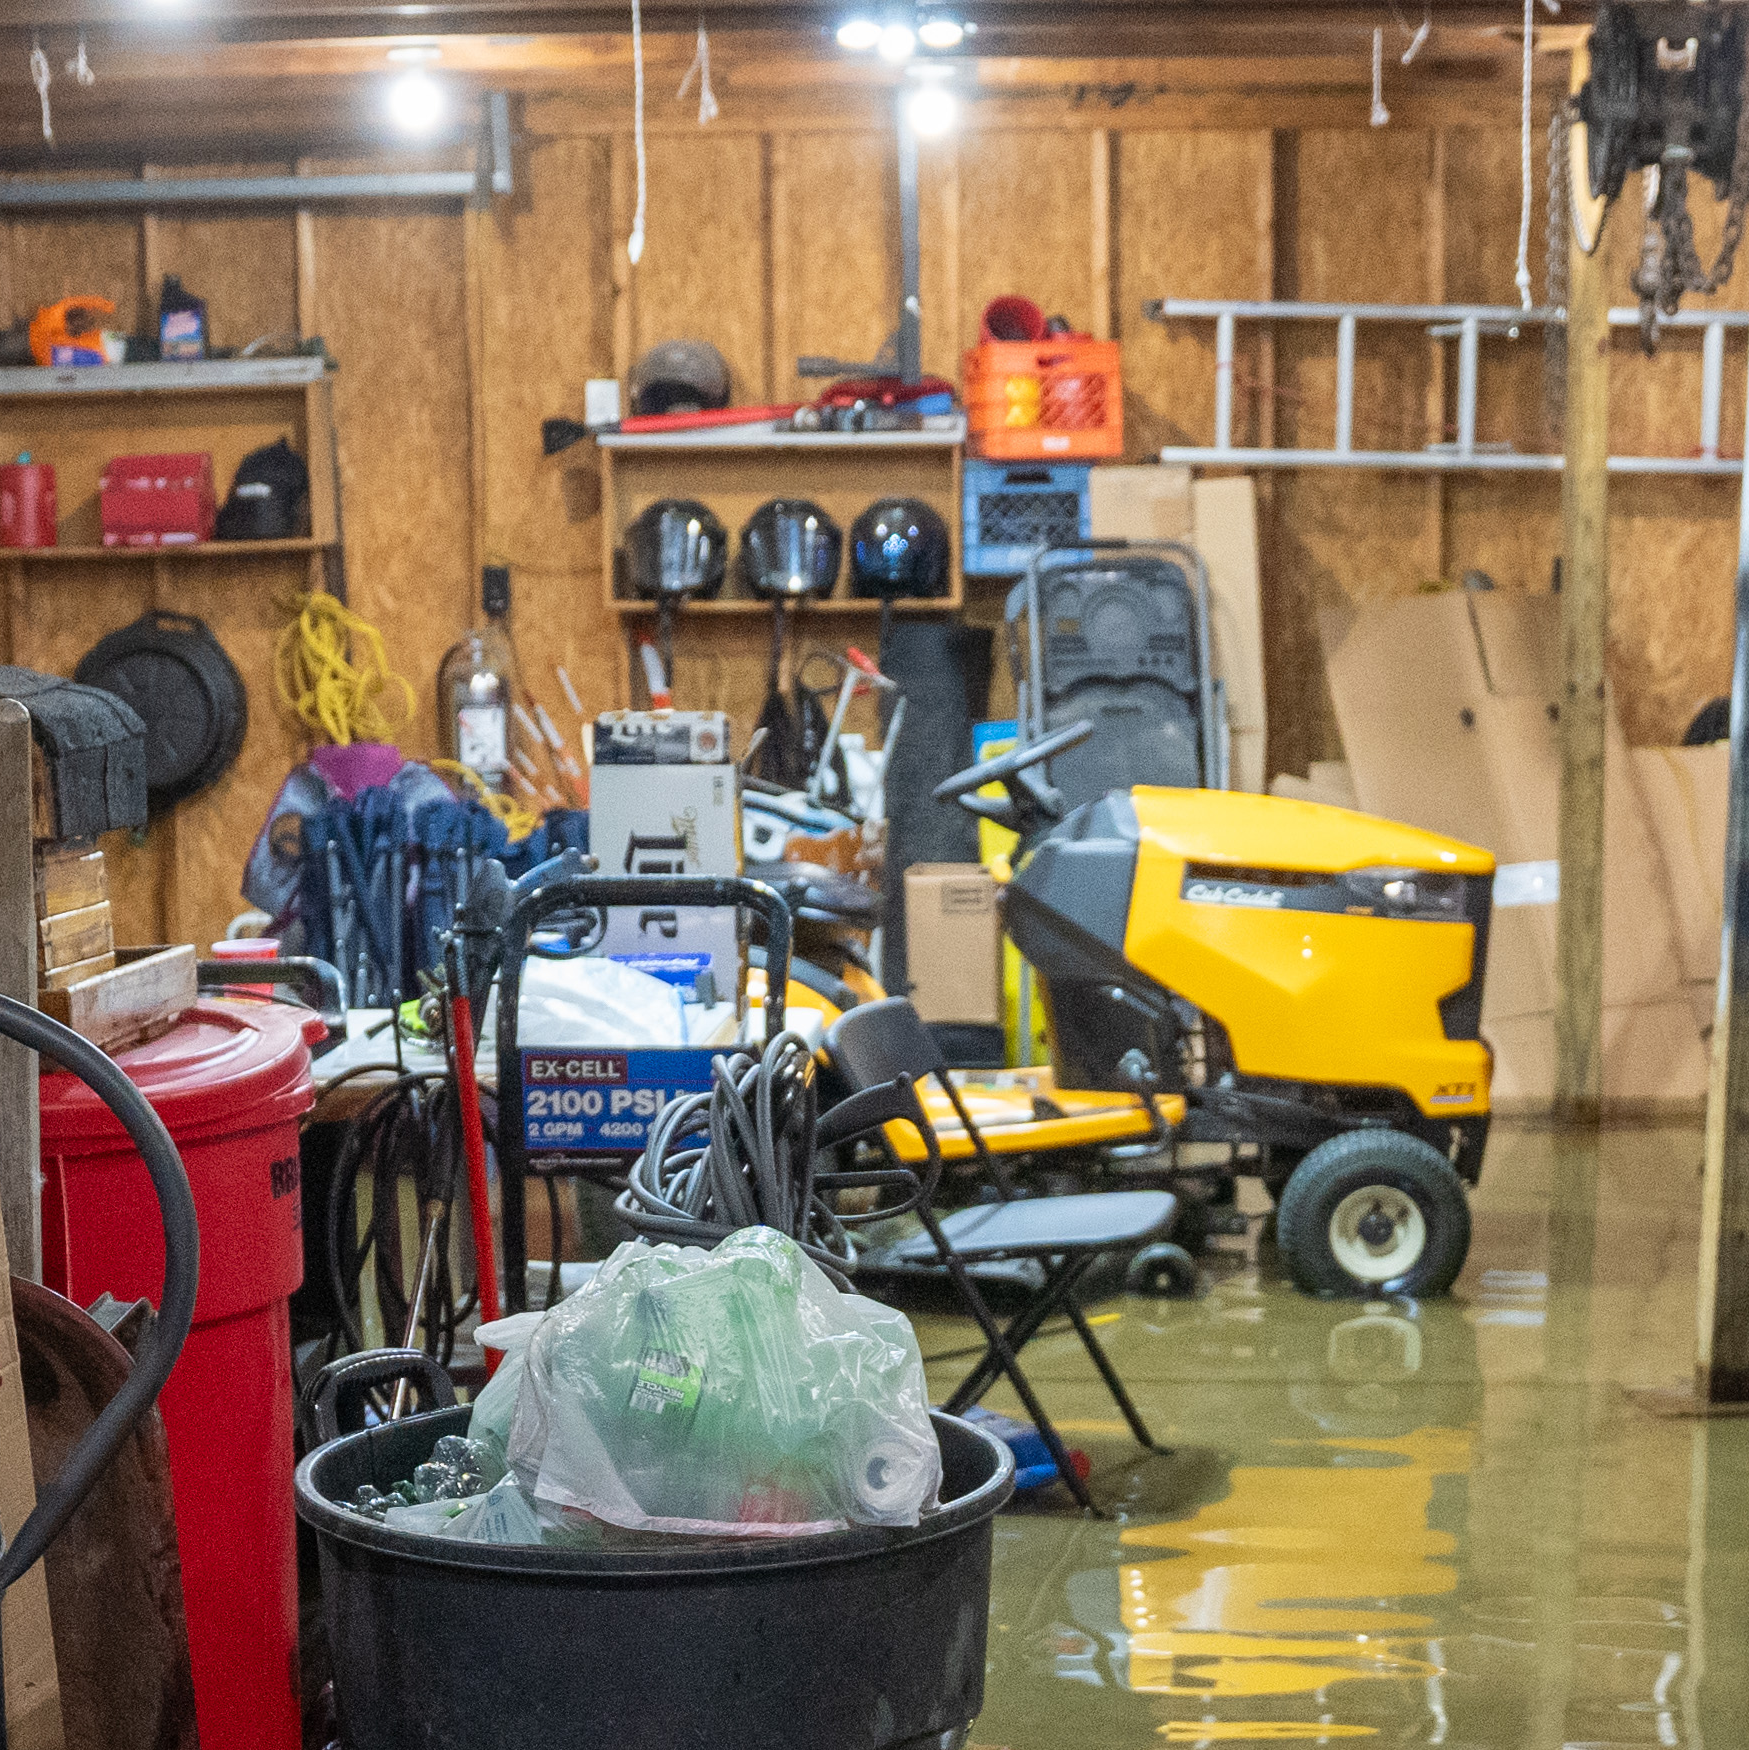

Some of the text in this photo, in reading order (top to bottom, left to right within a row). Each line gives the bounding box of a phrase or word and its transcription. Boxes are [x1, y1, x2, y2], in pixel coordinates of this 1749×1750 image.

[1186, 884, 1285, 908] Cub Cadet
[530, 1059, 621, 1080] EX-CELL
[527, 1089, 666, 1117] 2100 PSI
[527, 1122, 540, 1137] 2
[542, 1122, 585, 1138] GPM
[598, 1121, 644, 1137] 4200
